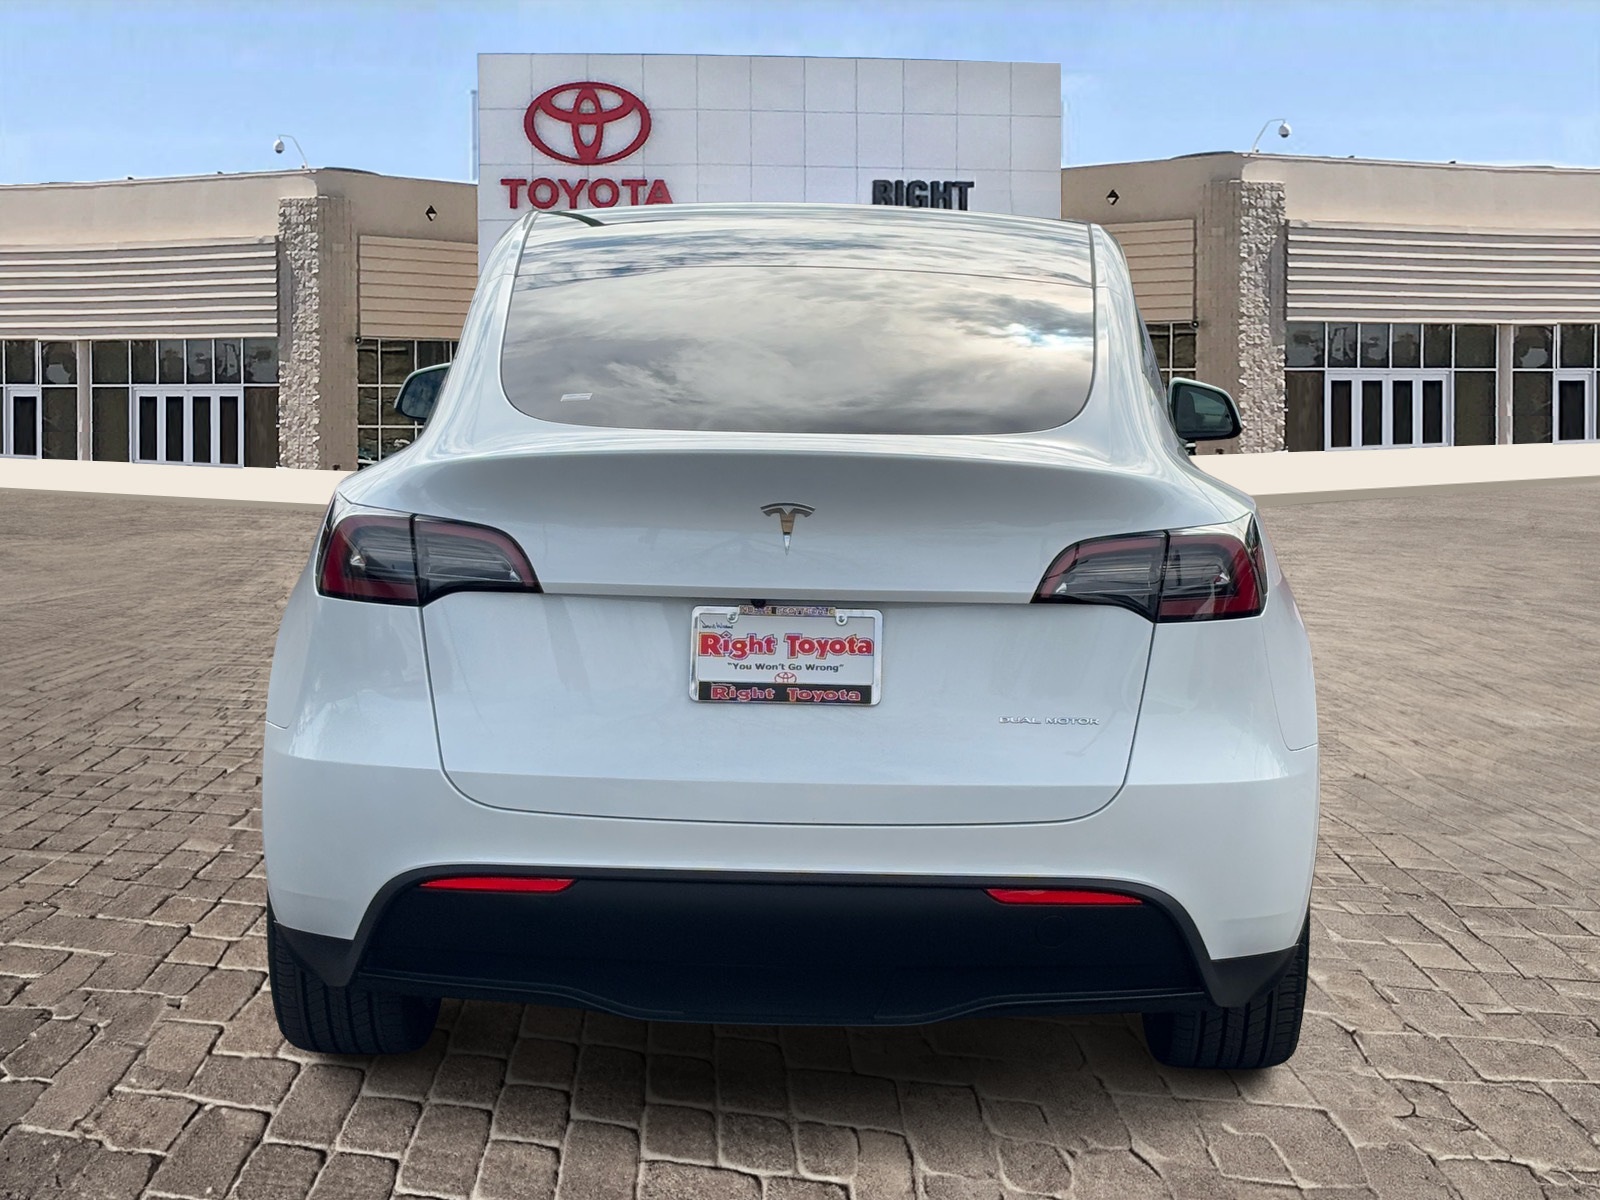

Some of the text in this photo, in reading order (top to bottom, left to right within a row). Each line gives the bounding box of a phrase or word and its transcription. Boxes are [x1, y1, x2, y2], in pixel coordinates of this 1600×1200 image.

[500, 177, 673, 209] TOYOTA
[872, 179, 975, 211] RIGHT
[698, 630, 875, 660] Right Toyota
[755, 663, 785, 671] Won't
[711, 685, 861, 702] Right Toyota
[999, 716, 1100, 726] DUAL MOTOR
